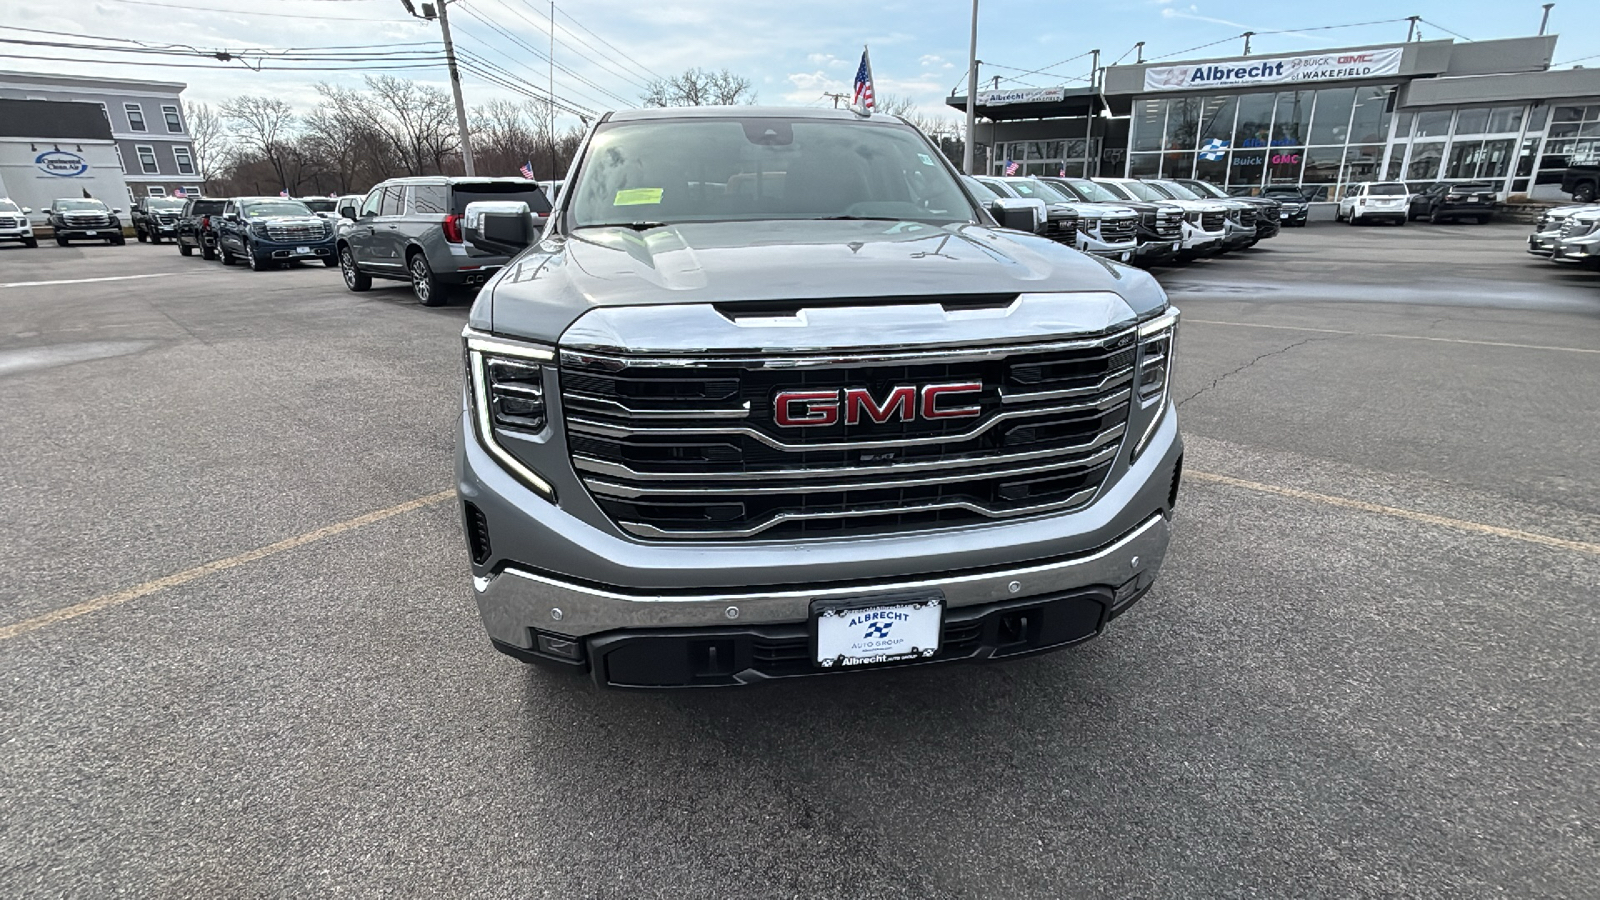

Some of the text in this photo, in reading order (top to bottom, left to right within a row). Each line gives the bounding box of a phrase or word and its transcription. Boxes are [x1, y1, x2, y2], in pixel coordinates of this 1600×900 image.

[1303, 54, 1374, 67] BUICK GMC
[1190, 61, 1284, 82] Albrecht
[1302, 67, 1371, 80] WAKEFIELD
[989, 93, 1024, 101] Albrecht
[1233, 156, 1262, 166] Buick
[1272, 154, 1299, 164] GMC
[773, 379, 983, 428] GMC
[848, 611, 910, 627] ALBRECHT
[851, 638, 904, 649] AUTO GROUP
[842, 653, 887, 666] Albrecht
